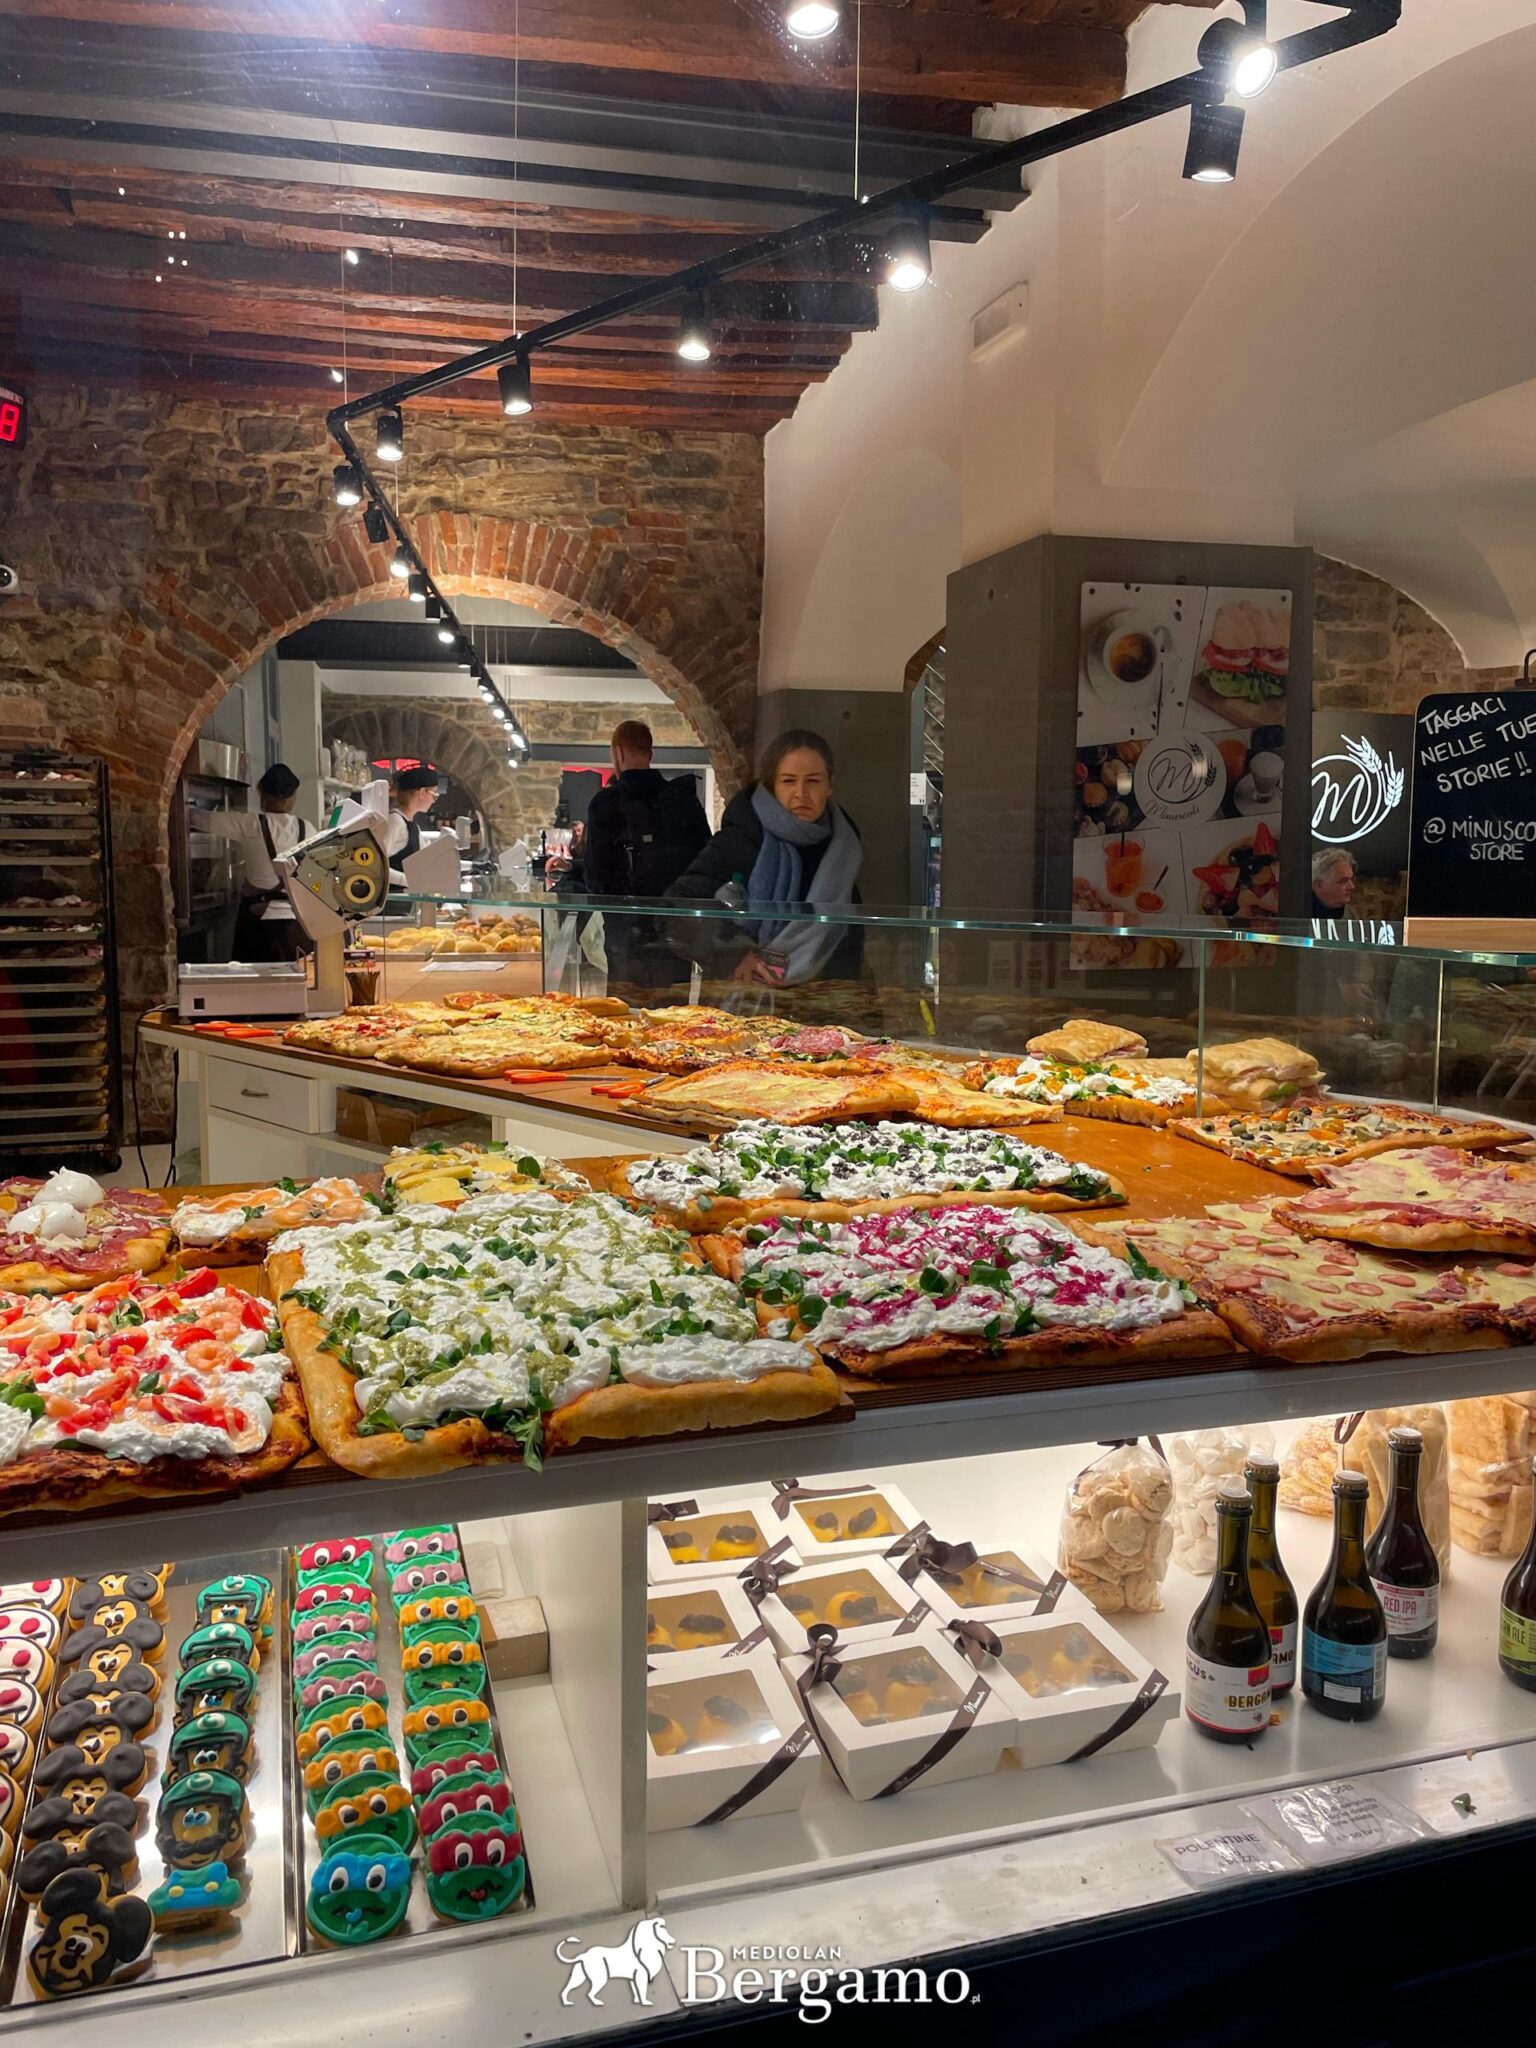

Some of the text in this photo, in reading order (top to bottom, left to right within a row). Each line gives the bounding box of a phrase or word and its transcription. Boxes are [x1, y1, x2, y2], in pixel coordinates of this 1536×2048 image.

[1418, 697, 1506, 735] TAGGACI
[1420, 713, 1536, 766] NELLE TUE
[1437, 757, 1511, 793] STORIE
[1470, 841, 1525, 861] STORE
[1383, 1596, 1400, 1613] RED
[1402, 1600, 1417, 1615] IPA
[1175, 1833, 1260, 1855] POLENTINE
